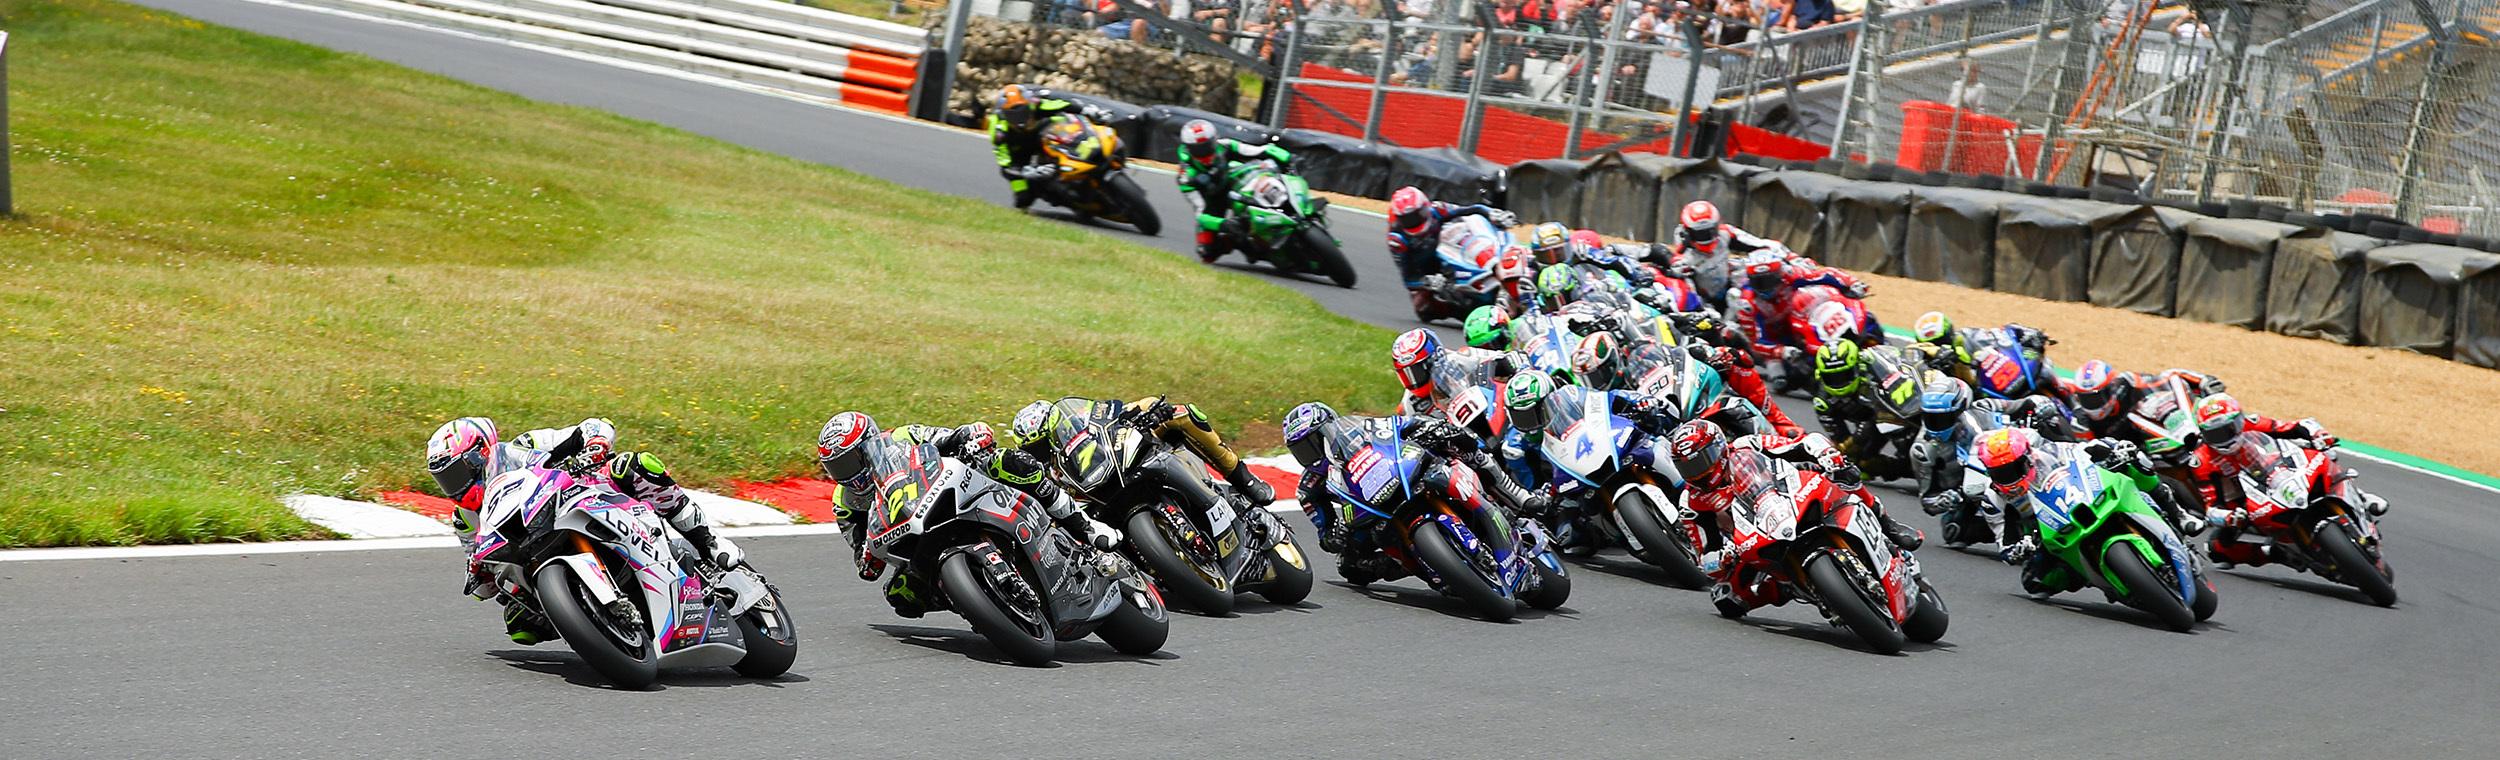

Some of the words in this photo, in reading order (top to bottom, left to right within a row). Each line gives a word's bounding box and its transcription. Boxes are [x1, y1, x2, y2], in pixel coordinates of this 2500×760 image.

[1991, 360, 2021, 391] 53
[1455, 400, 1479, 425] 91
[1078, 440, 1098, 476] 7
[1575, 432, 1594, 460] 4
[959, 468, 973, 493] R&G
[1351, 452, 1383, 483] McAMS
[1359, 458, 1392, 501] 22
[926, 469, 953, 504] OXFORD
[1370, 477, 1400, 505] MONSTER
[2054, 485, 2086, 514] 14
[632, 506, 647, 517] 52
[888, 482, 919, 524] 21
[605, 510, 677, 577] LOVELL
[882, 523, 911, 543] OXFORD
